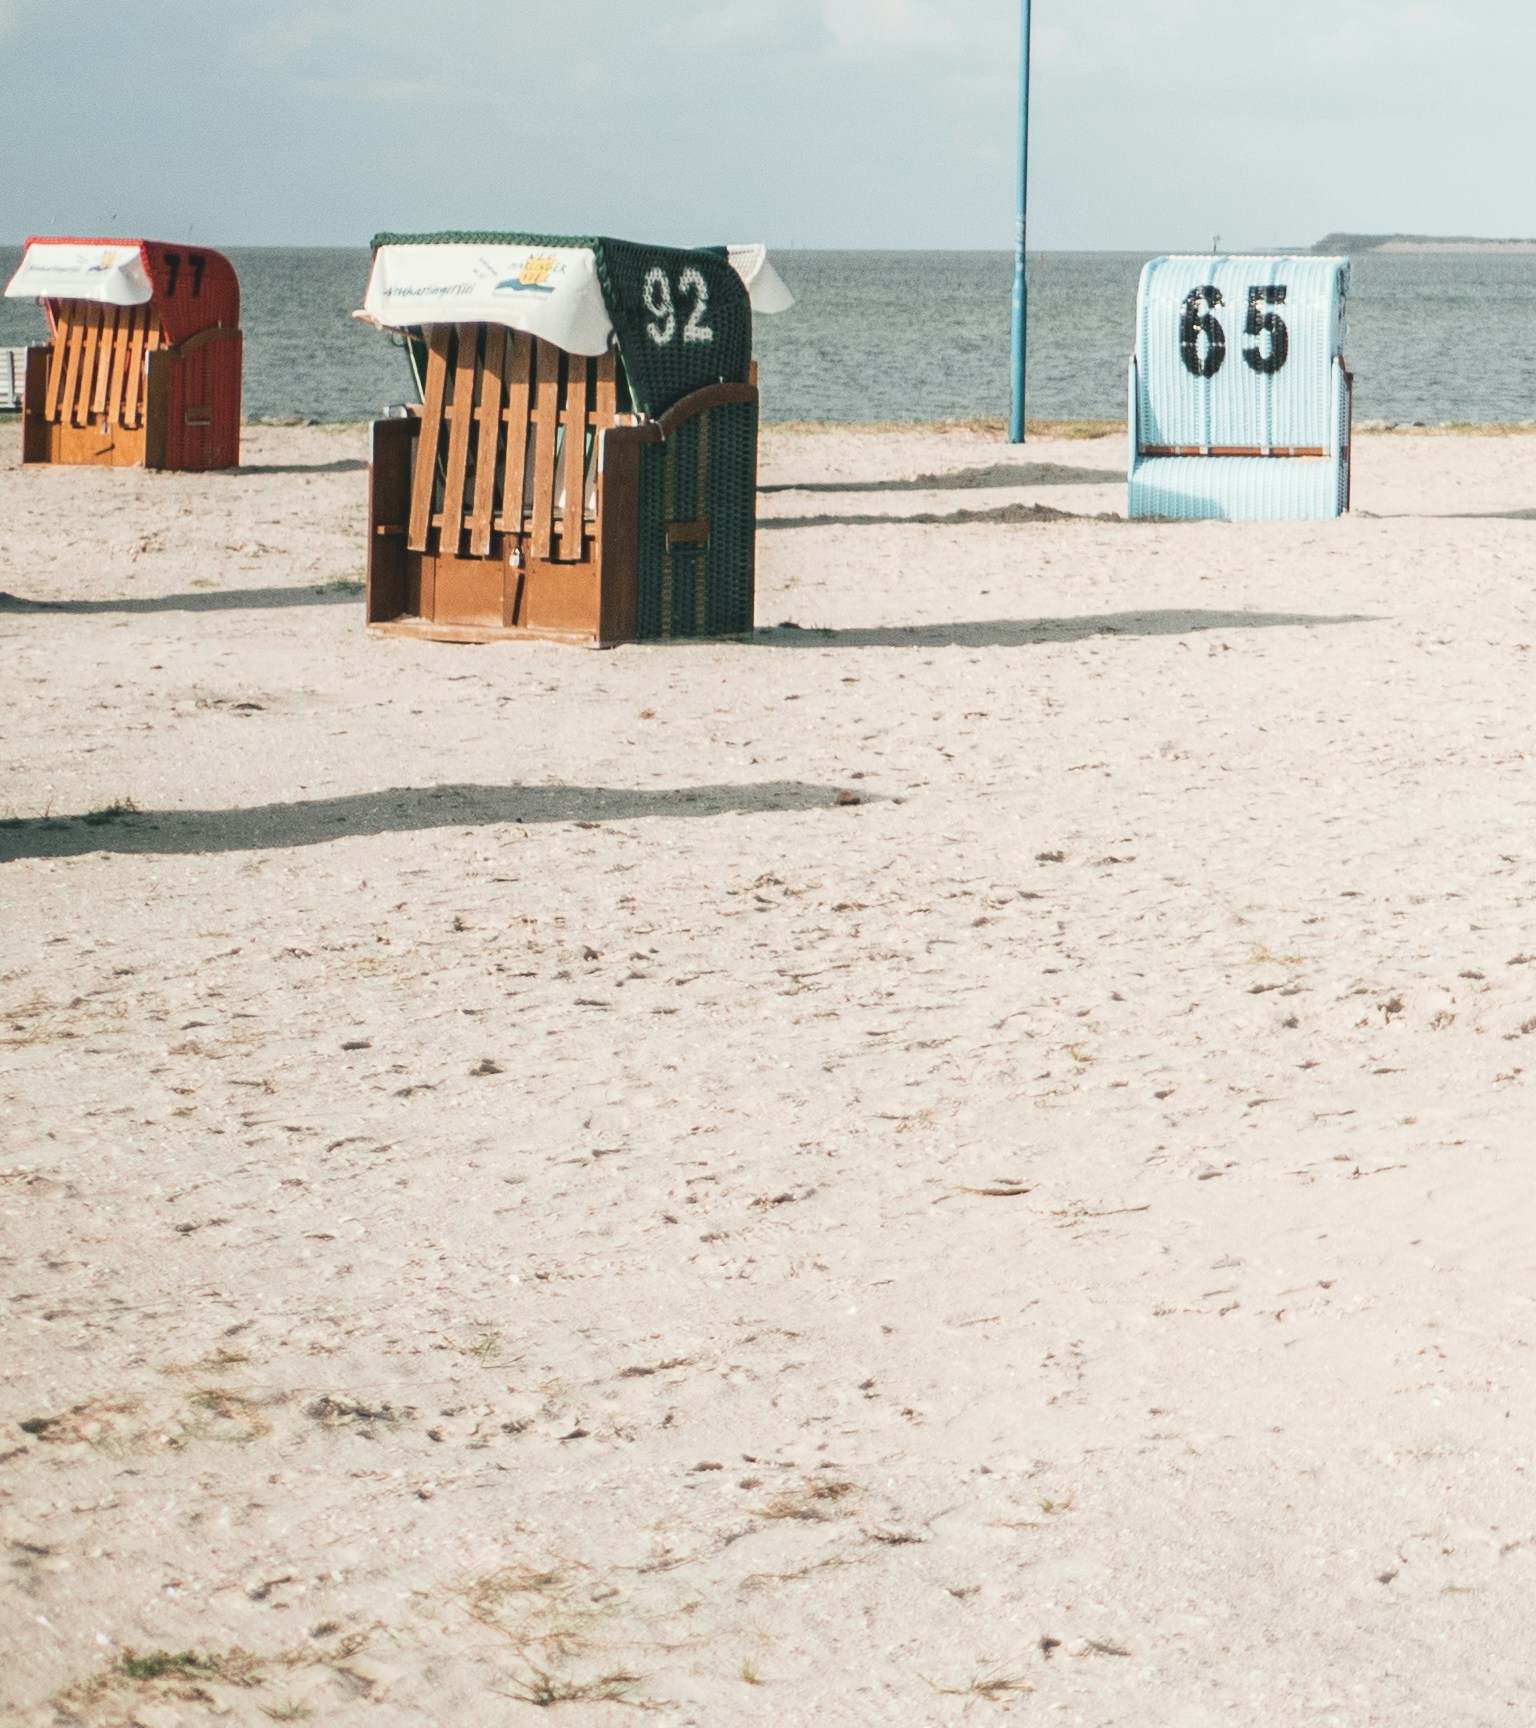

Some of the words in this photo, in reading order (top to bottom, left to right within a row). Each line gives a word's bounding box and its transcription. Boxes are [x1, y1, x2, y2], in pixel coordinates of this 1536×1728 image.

[163, 253, 205, 297] 77
[643, 267, 713, 345] 92
[1180, 284, 1289, 378] 65
